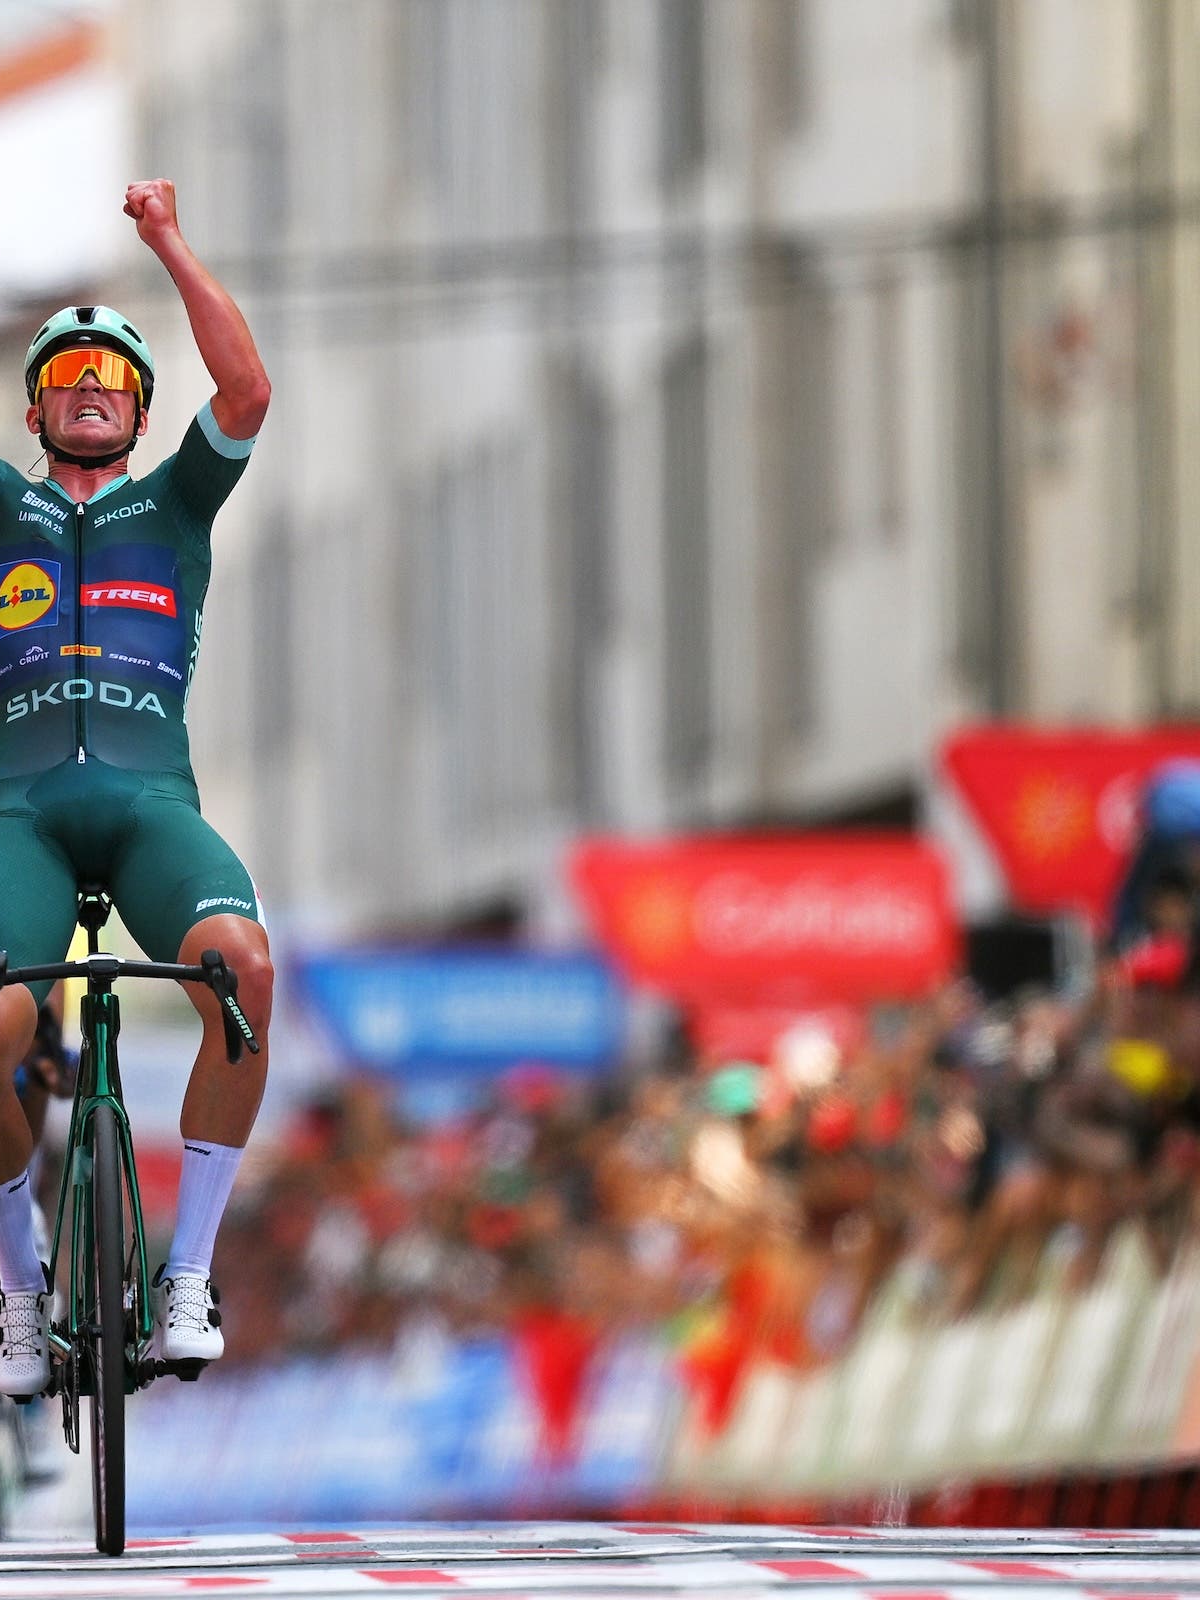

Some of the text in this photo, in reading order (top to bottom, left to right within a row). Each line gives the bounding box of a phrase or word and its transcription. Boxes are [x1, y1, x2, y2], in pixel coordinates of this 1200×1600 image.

[21, 490, 70, 521] Santini
[94, 499, 158, 529] SKODA
[28, 512, 52, 528] VUELTA
[52, 523, 64, 535] 25
[87, 588, 169, 607] TREK
[19, 651, 50, 666] CRIVIT
[108, 653, 151, 667] SRAM
[157, 662, 183, 681] Santini
[6, 678, 167, 723] SKODA
[195, 897, 253, 913] Santini
[224, 996, 255, 1039] SRAM
